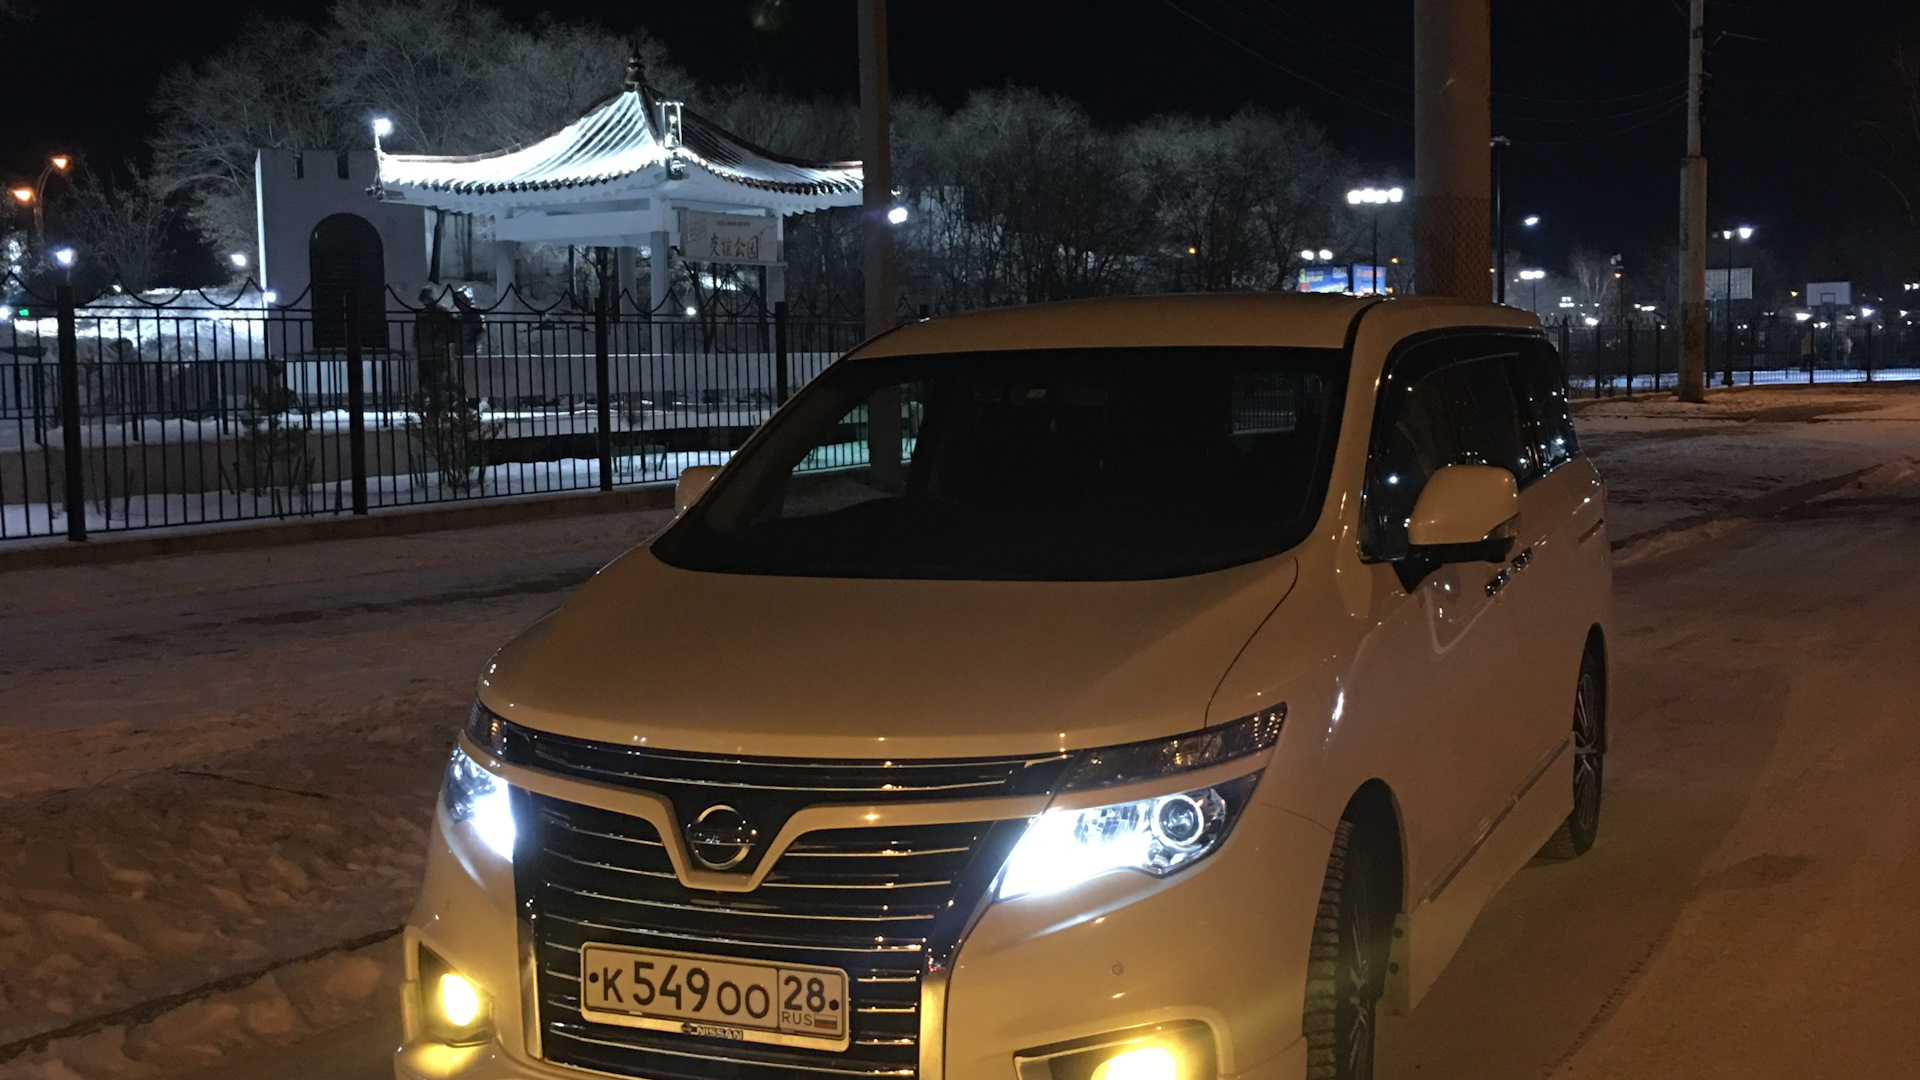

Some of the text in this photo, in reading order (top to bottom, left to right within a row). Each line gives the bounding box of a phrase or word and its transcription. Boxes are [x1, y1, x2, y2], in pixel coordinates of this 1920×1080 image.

[784, 975, 826, 1013] 28
[782, 1011, 813, 1027] RUS
[696, 1025, 744, 1041] NISSAN
